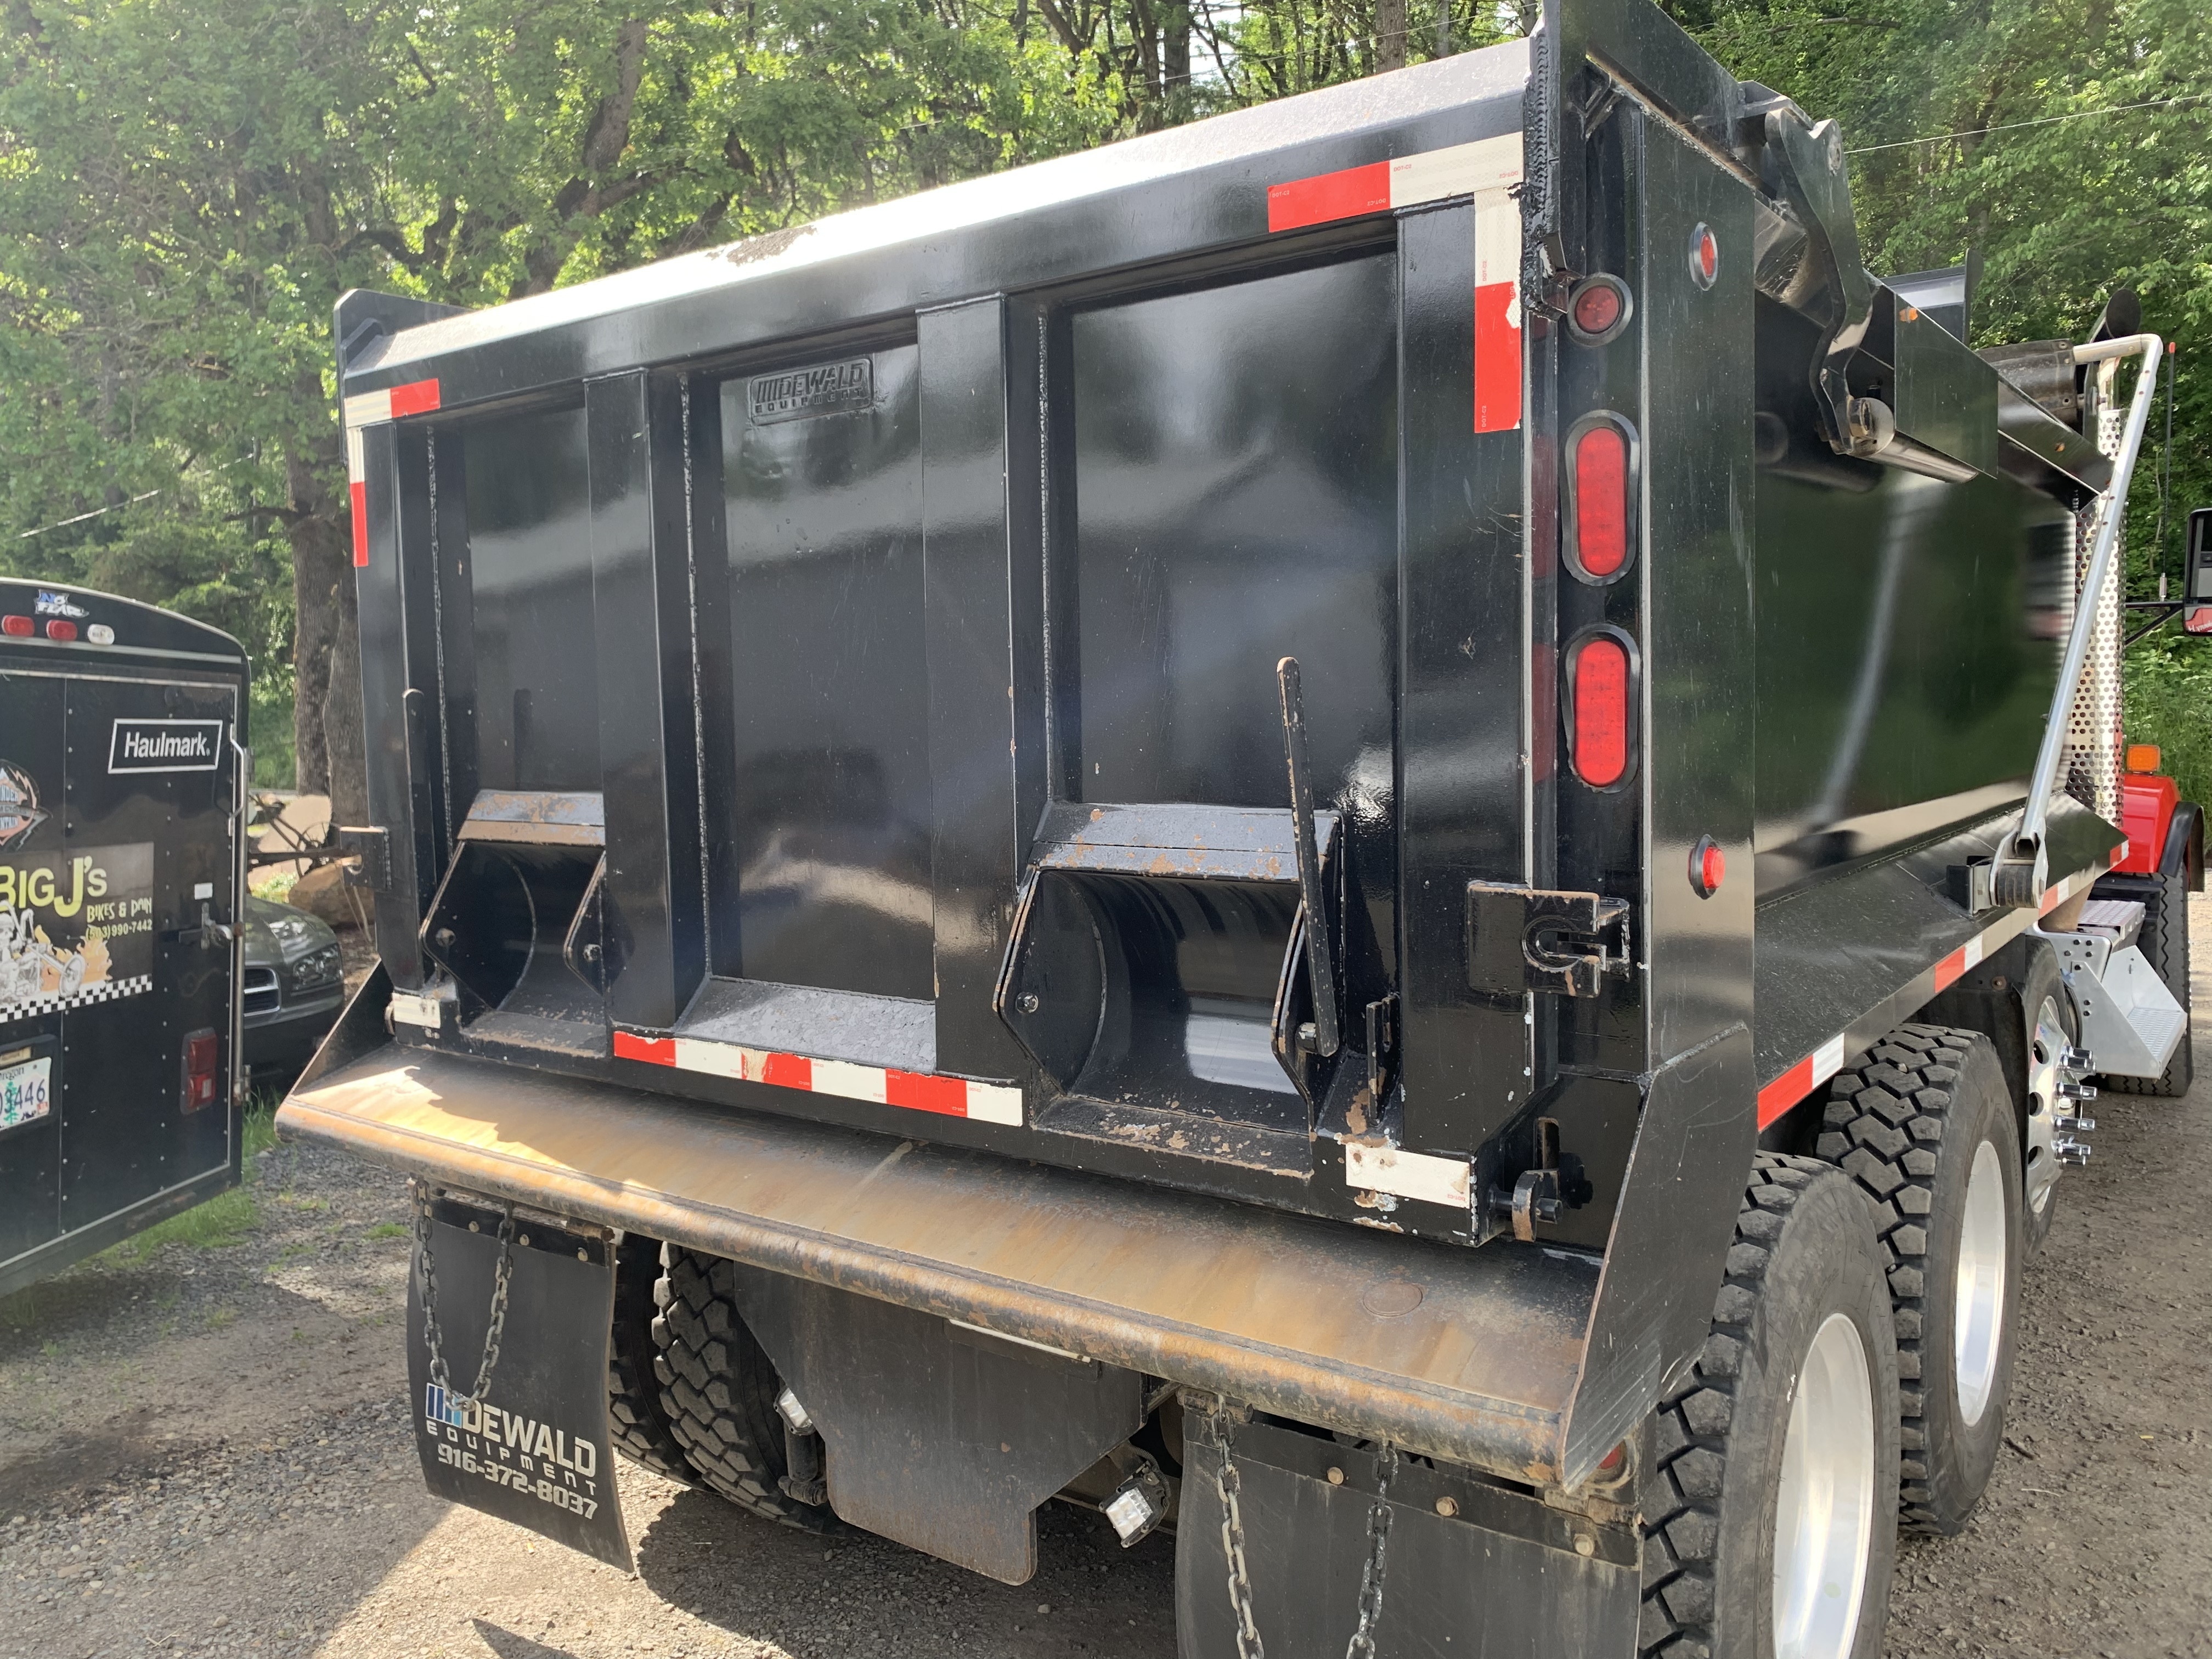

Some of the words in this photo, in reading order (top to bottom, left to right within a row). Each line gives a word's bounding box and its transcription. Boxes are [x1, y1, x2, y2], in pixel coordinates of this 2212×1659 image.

[1499, 171, 1519, 179] DOT-C2
[1272, 190, 1290, 198] DOT-C2
[1367, 198, 1386, 206] DOT-C2
[779, 363, 865, 400] DEWALD
[754, 386, 863, 414] EQUIPMENT
[87, 902, 115, 923] BIKES
[119, 901, 127, 918] &
[462, 1400, 596, 1477] DEWALD
[426, 1420, 596, 1496] EQUIPMENT
[438, 1443, 598, 1520] 916-372-8037
